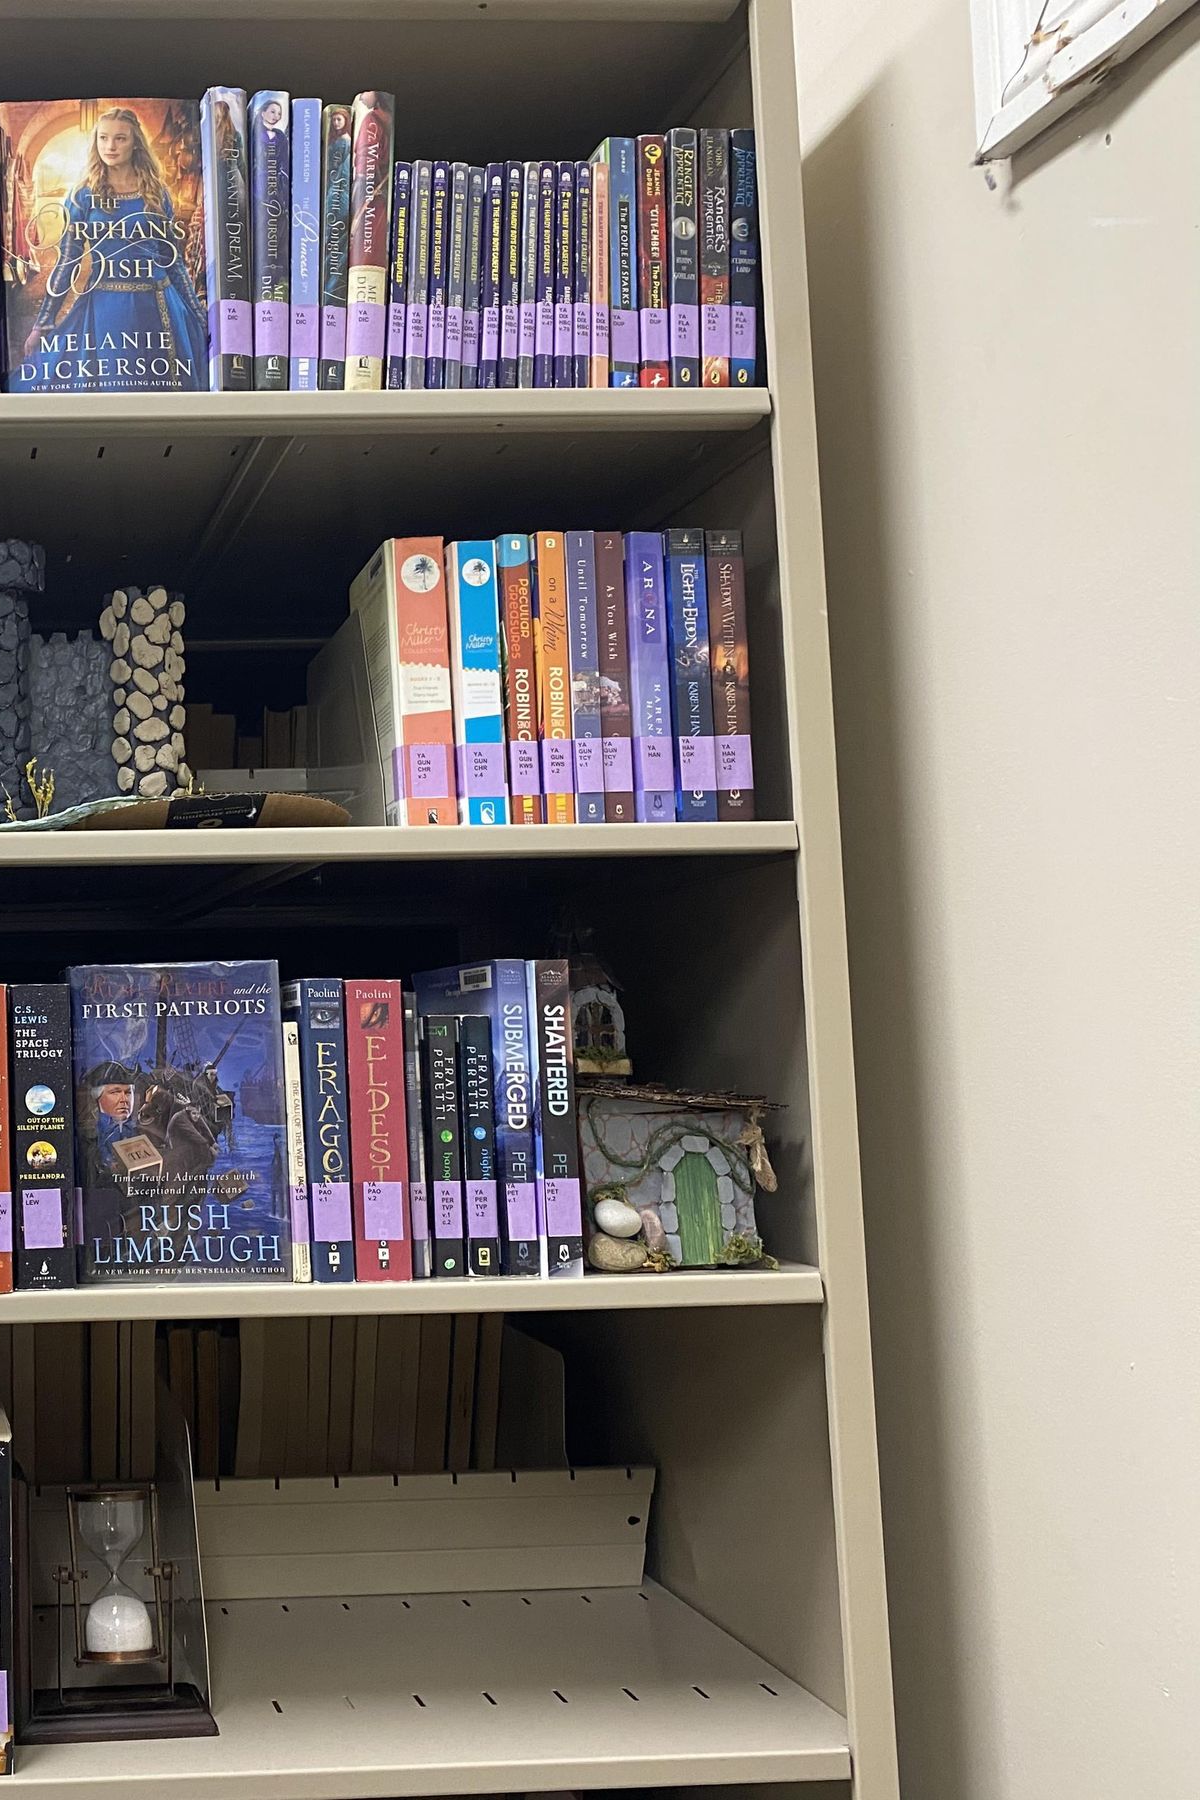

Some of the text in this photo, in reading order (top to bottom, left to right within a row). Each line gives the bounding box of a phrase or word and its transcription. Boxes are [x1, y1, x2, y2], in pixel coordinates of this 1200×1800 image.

[25, 202, 186, 249] ORPHAN'S
[620, 223, 628, 255] PEOPLE
[621, 257, 628, 266] of
[40, 332, 171, 352] MELANIE
[20, 358, 192, 381] DICKERSON
[606, 586, 613, 599] As
[578, 560, 588, 660] Until Tomorrow
[608, 632, 616, 660] Wish
[233, 983, 272, 994] and the
[308, 988, 339, 998] Paolini
[356, 989, 391, 999] Paolini
[82, 999, 265, 1018] FIRST PATRIOTS
[15, 1016, 47, 1024] LEWIS
[16, 1040, 48, 1048] SPACE
[16, 1050, 62, 1058] TRILOGY
[544, 1004, 568, 1116] SHATTERED
[504, 1004, 527, 1130] SUBMERGED
[434, 1049, 445, 1121] PERETTI
[112, 1172, 256, 1182] Time-Travel Adventures with
[127, 1185, 242, 1196] Exceptional Americans
[139, 1205, 231, 1231] RUSH
[93, 1235, 281, 1264] LIMBAUGH
